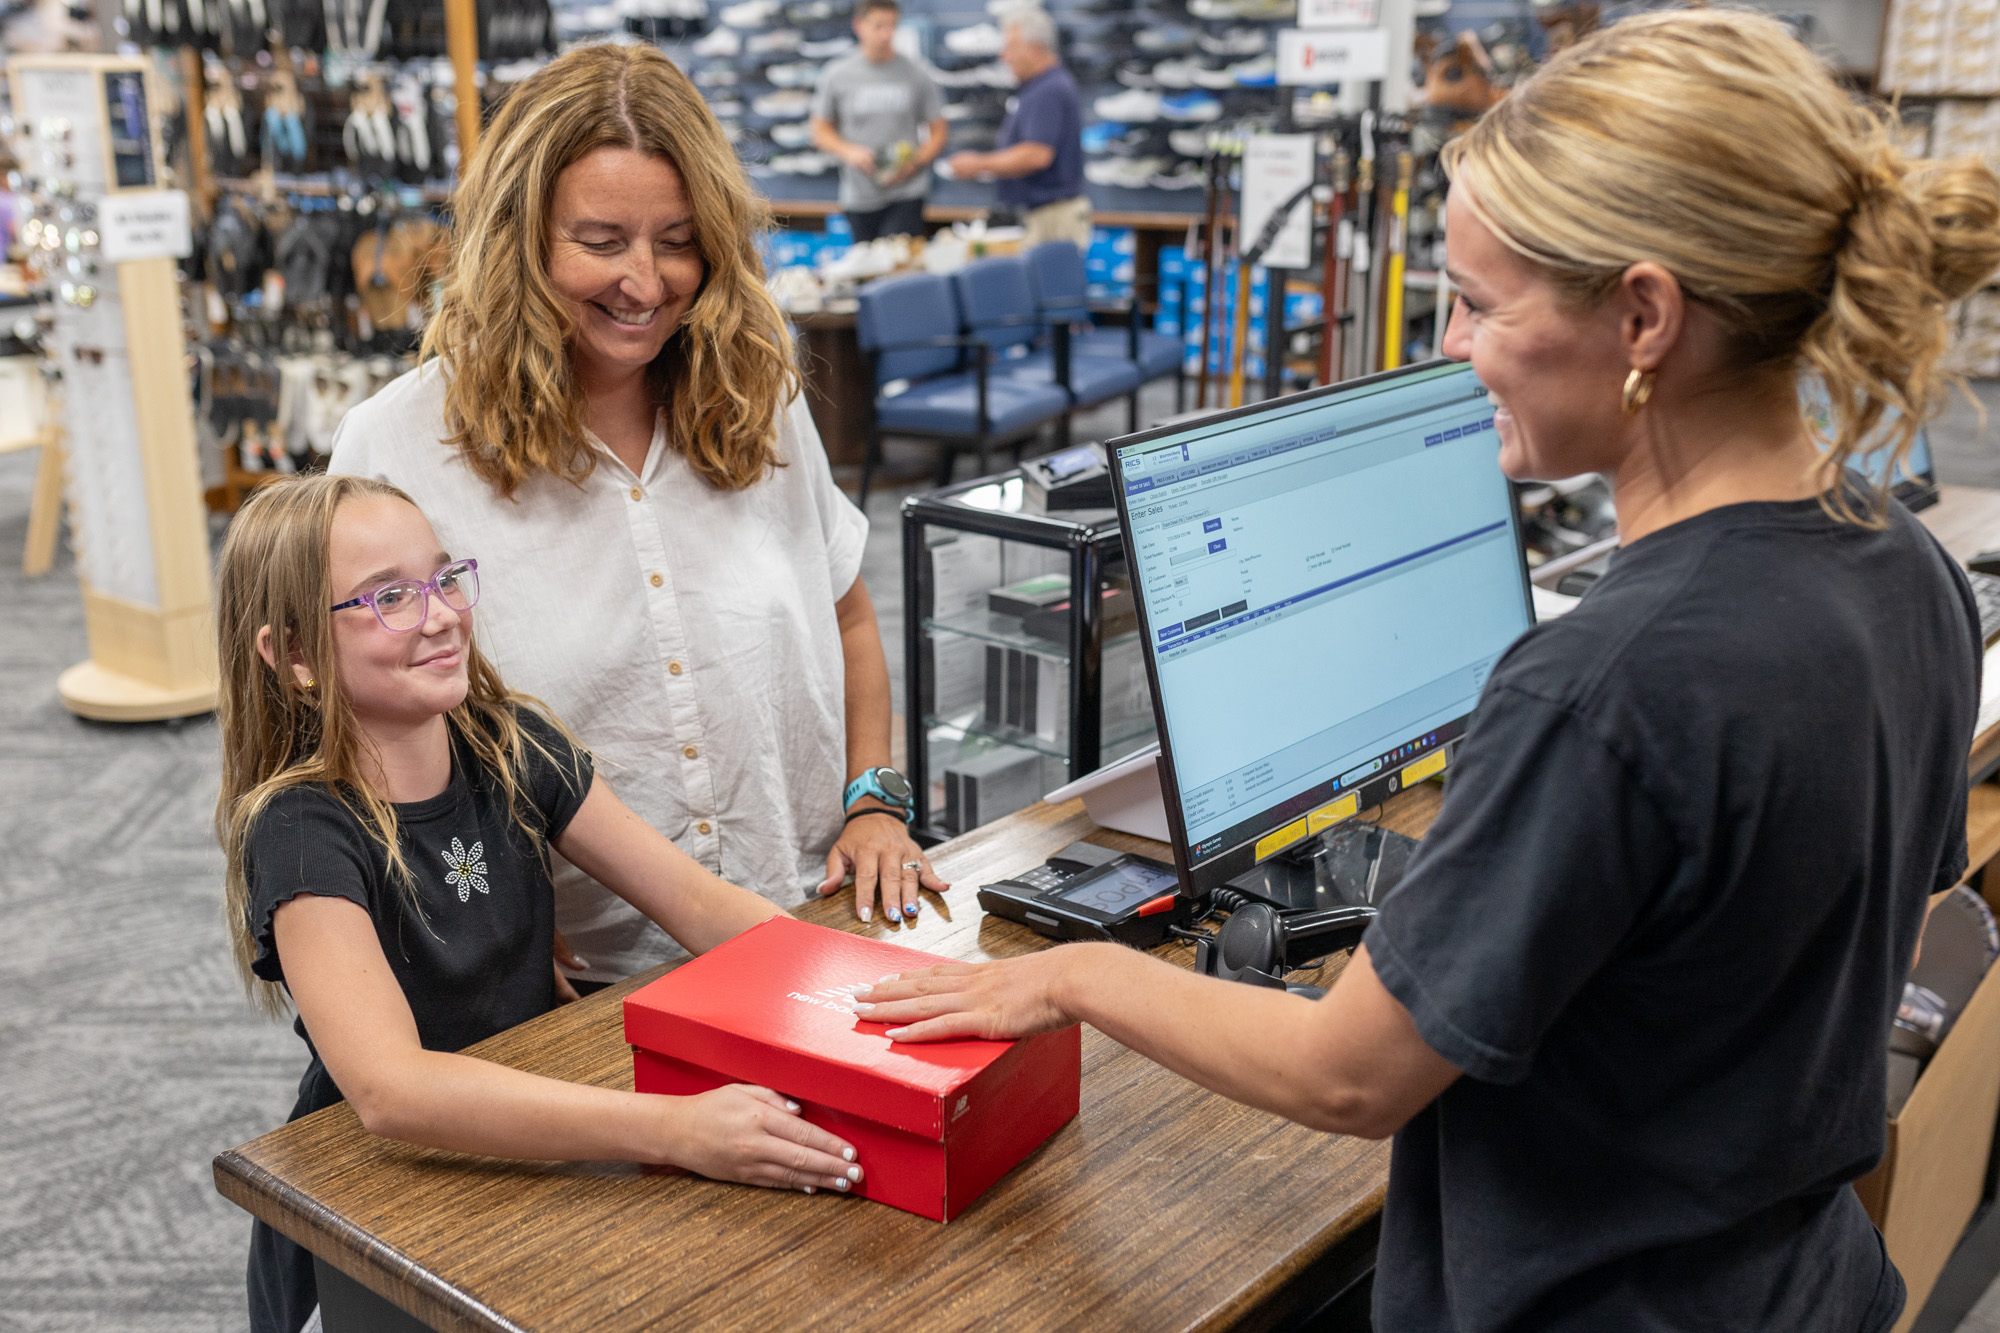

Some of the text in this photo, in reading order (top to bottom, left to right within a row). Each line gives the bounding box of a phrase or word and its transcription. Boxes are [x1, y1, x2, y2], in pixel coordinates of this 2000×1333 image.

[1125, 458, 1140, 468] RICS
[1131, 505, 1163, 520] Enter Sales
[1388, 776, 1398, 793] hp
[787, 991, 824, 1005] new
